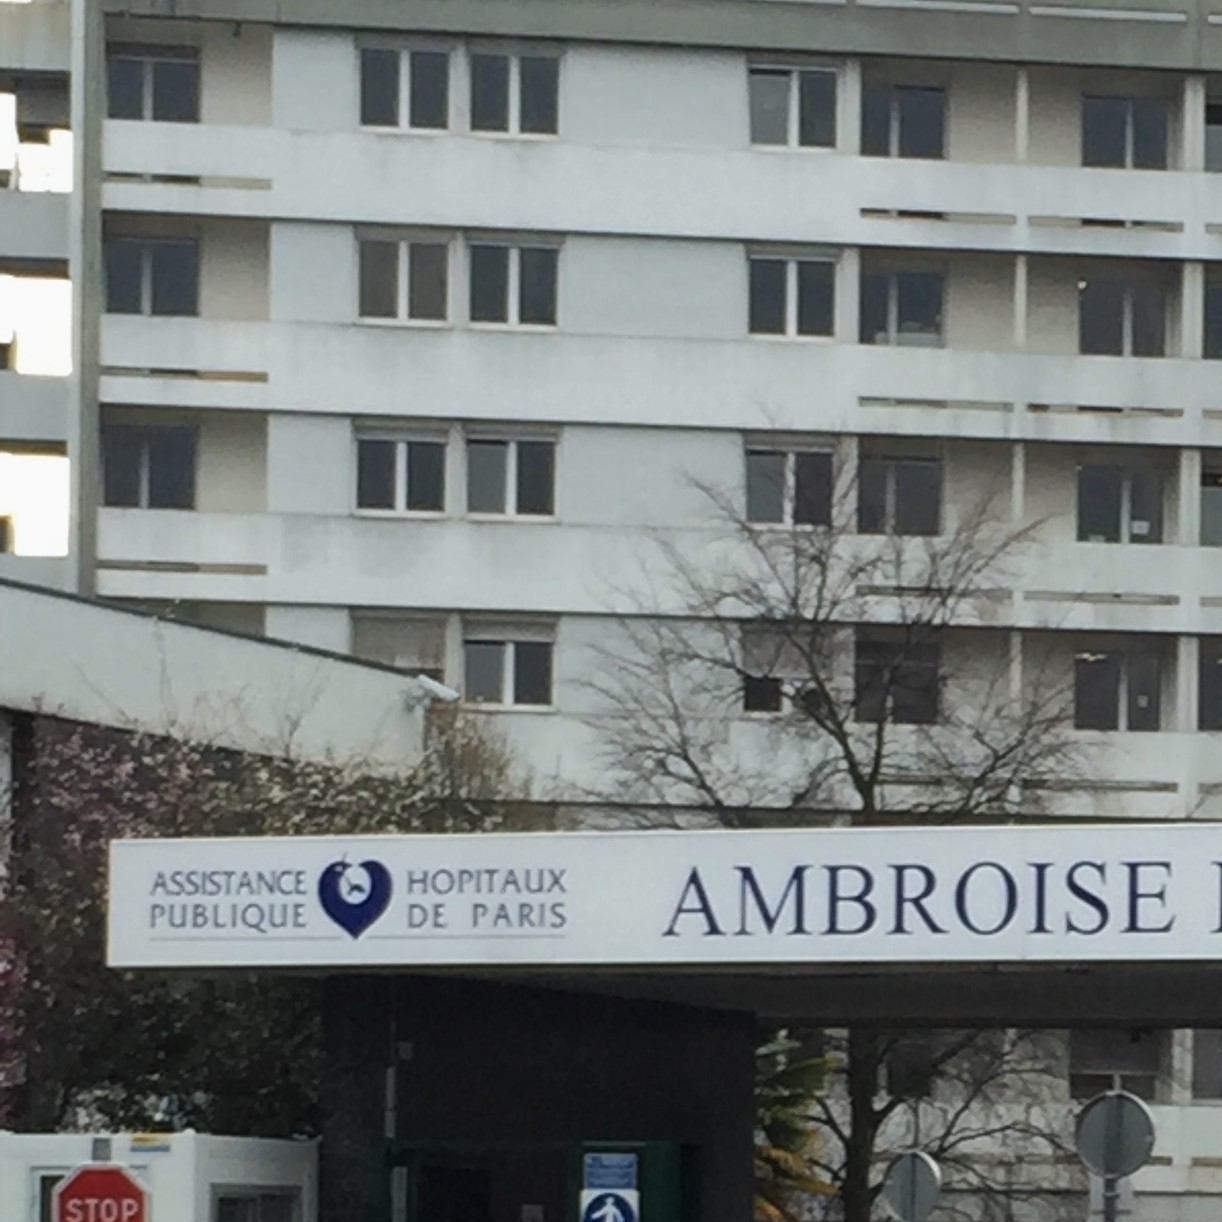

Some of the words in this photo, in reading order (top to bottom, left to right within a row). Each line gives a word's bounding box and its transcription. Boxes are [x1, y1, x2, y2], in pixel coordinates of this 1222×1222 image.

[150, 869, 307, 897] ASSISTANCE
[407, 868, 567, 895] HOPITAUX
[661, 859, 1176, 938] AMBROISE
[149, 903, 307, 934] PUBLIQUE
[407, 903, 448, 929] DE
[473, 902, 567, 929] PARIS
